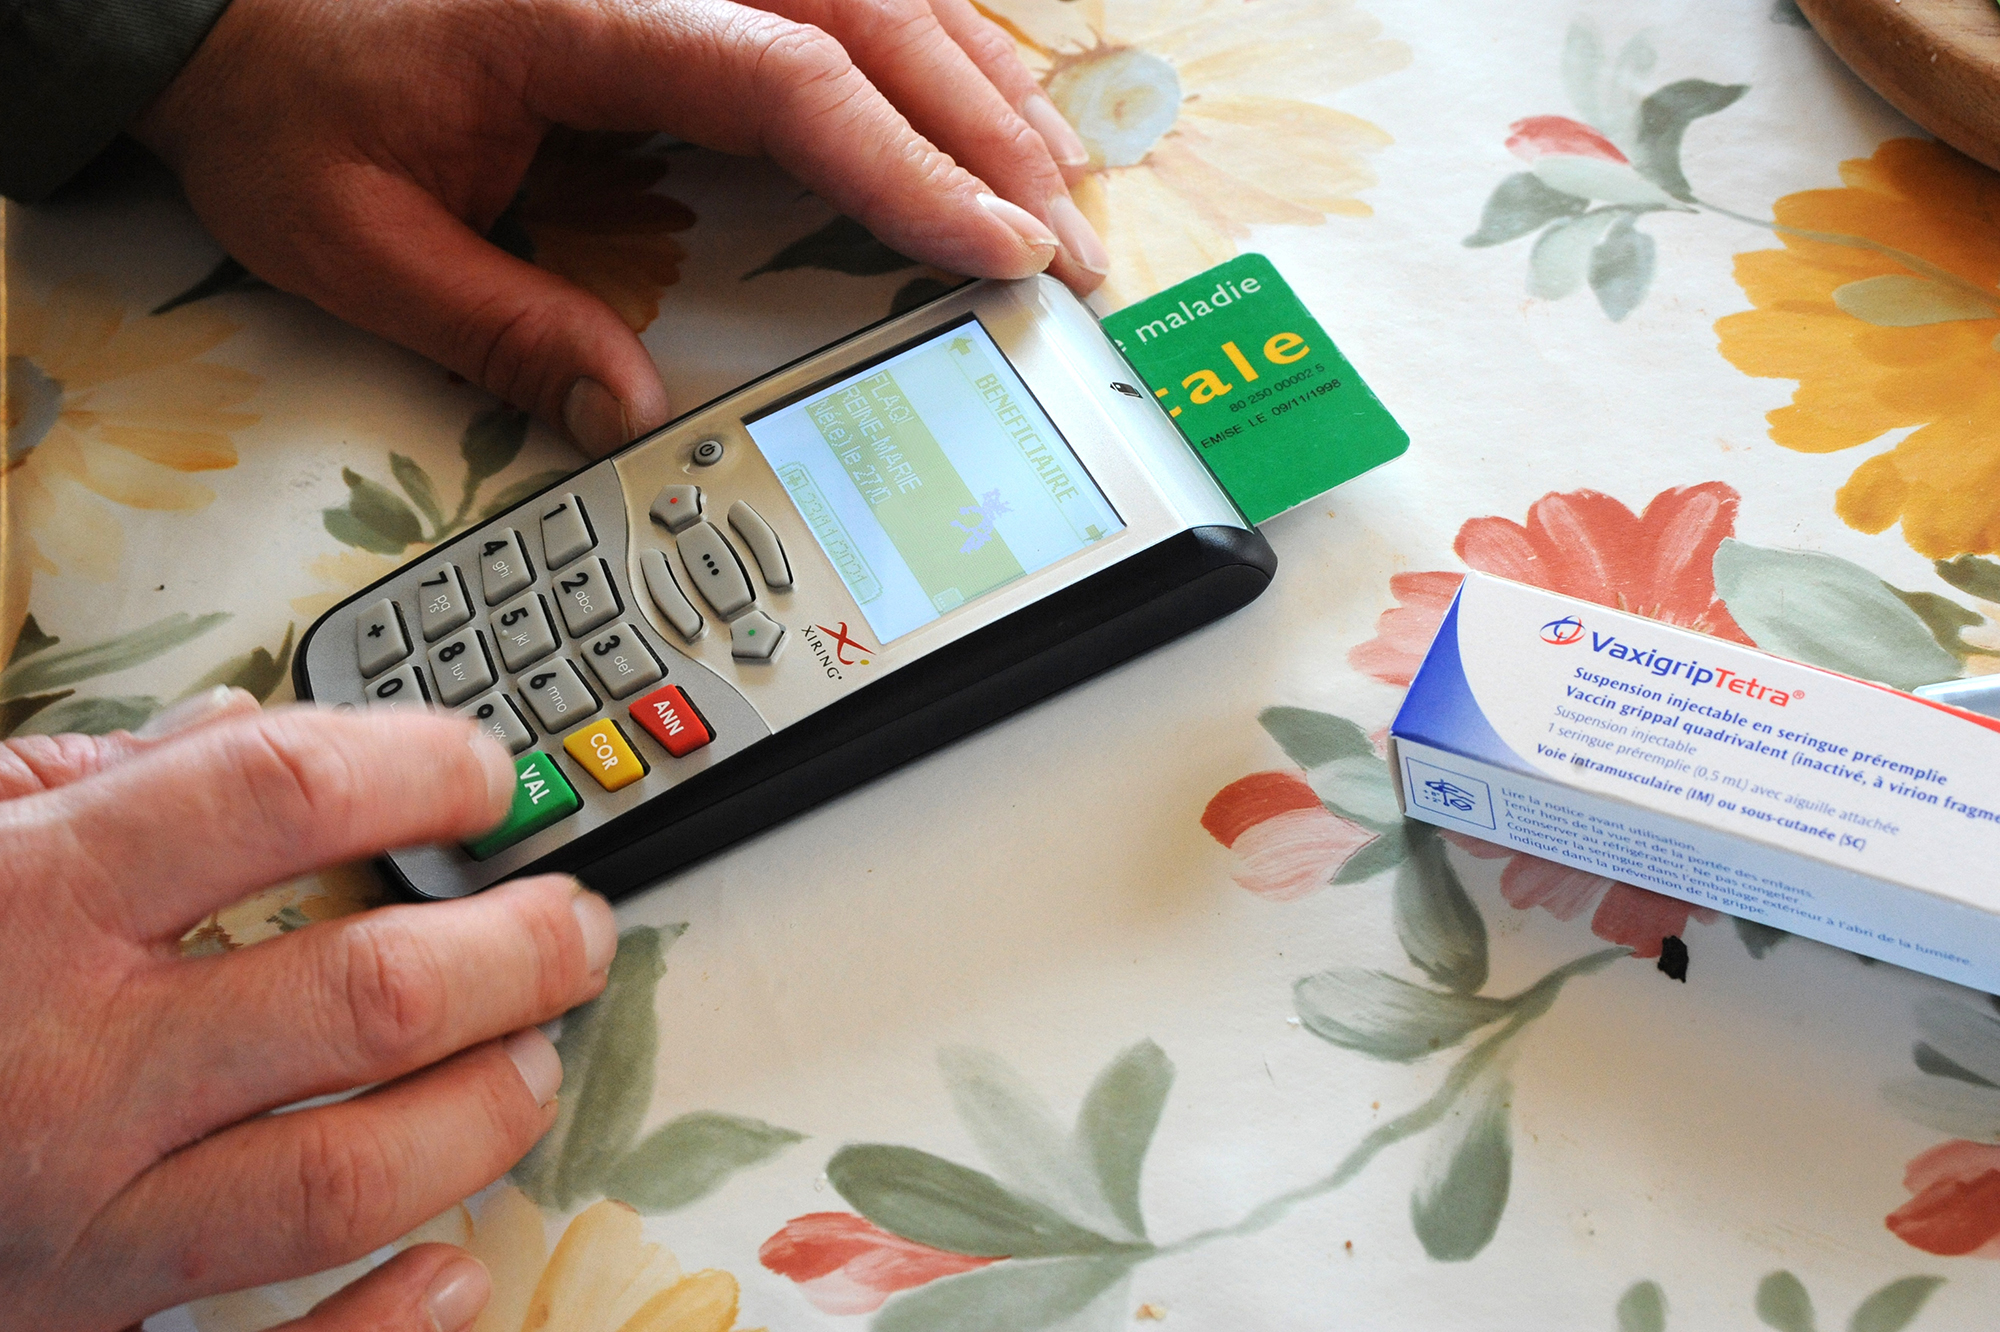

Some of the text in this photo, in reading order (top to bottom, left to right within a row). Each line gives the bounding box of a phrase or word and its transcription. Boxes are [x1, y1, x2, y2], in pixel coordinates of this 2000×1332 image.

[1135, 277, 1261, 343] maladie
[1229, 363, 1325, 413] 80 250 00002 5
[1201, 378, 1342, 450] EMISE LE 09/11/1998
[838, 386, 923, 494] REINE-MARIE
[841, 445, 861, 465] le
[974, 373, 1079, 504] BENEFICIAIRE
[543, 503, 567, 520] 1
[420, 571, 448, 588] 7
[483, 540, 513, 579] 4 ghi
[560, 572, 594, 615] 2 abc
[500, 607, 530, 647] 5 jkl
[438, 641, 467, 682] 8 tuv
[593, 634, 634, 677] 3 def
[376, 677, 403, 698] 0
[529, 671, 568, 714] 6 mno
[467, 703, 494, 720] 9
[653, 699, 684, 737] ANN
[1554, 705, 1697, 755] Suspension injectable
[1574, 667, 1947, 785] Suspension injectable en seringue préremplie
[589, 732, 618, 771] COR
[1567, 685, 1616, 709] Vaccin
[1619, 704, 1680, 728] grippal
[1682, 722, 1788, 760] quadrivalent
[1791, 752, 1866, 785] (inactivé,
[1873, 776, 1883, 788] à
[1890, 782, 1938, 805] virion
[519, 763, 551, 805] VAL
[1537, 743, 1866, 851] Voie intramusculaire (IM) ou sous-cutanée (SC)
[1548, 722, 1900, 835] 1 seringue préremplie (0,5 mL) avec aiguille attachée
